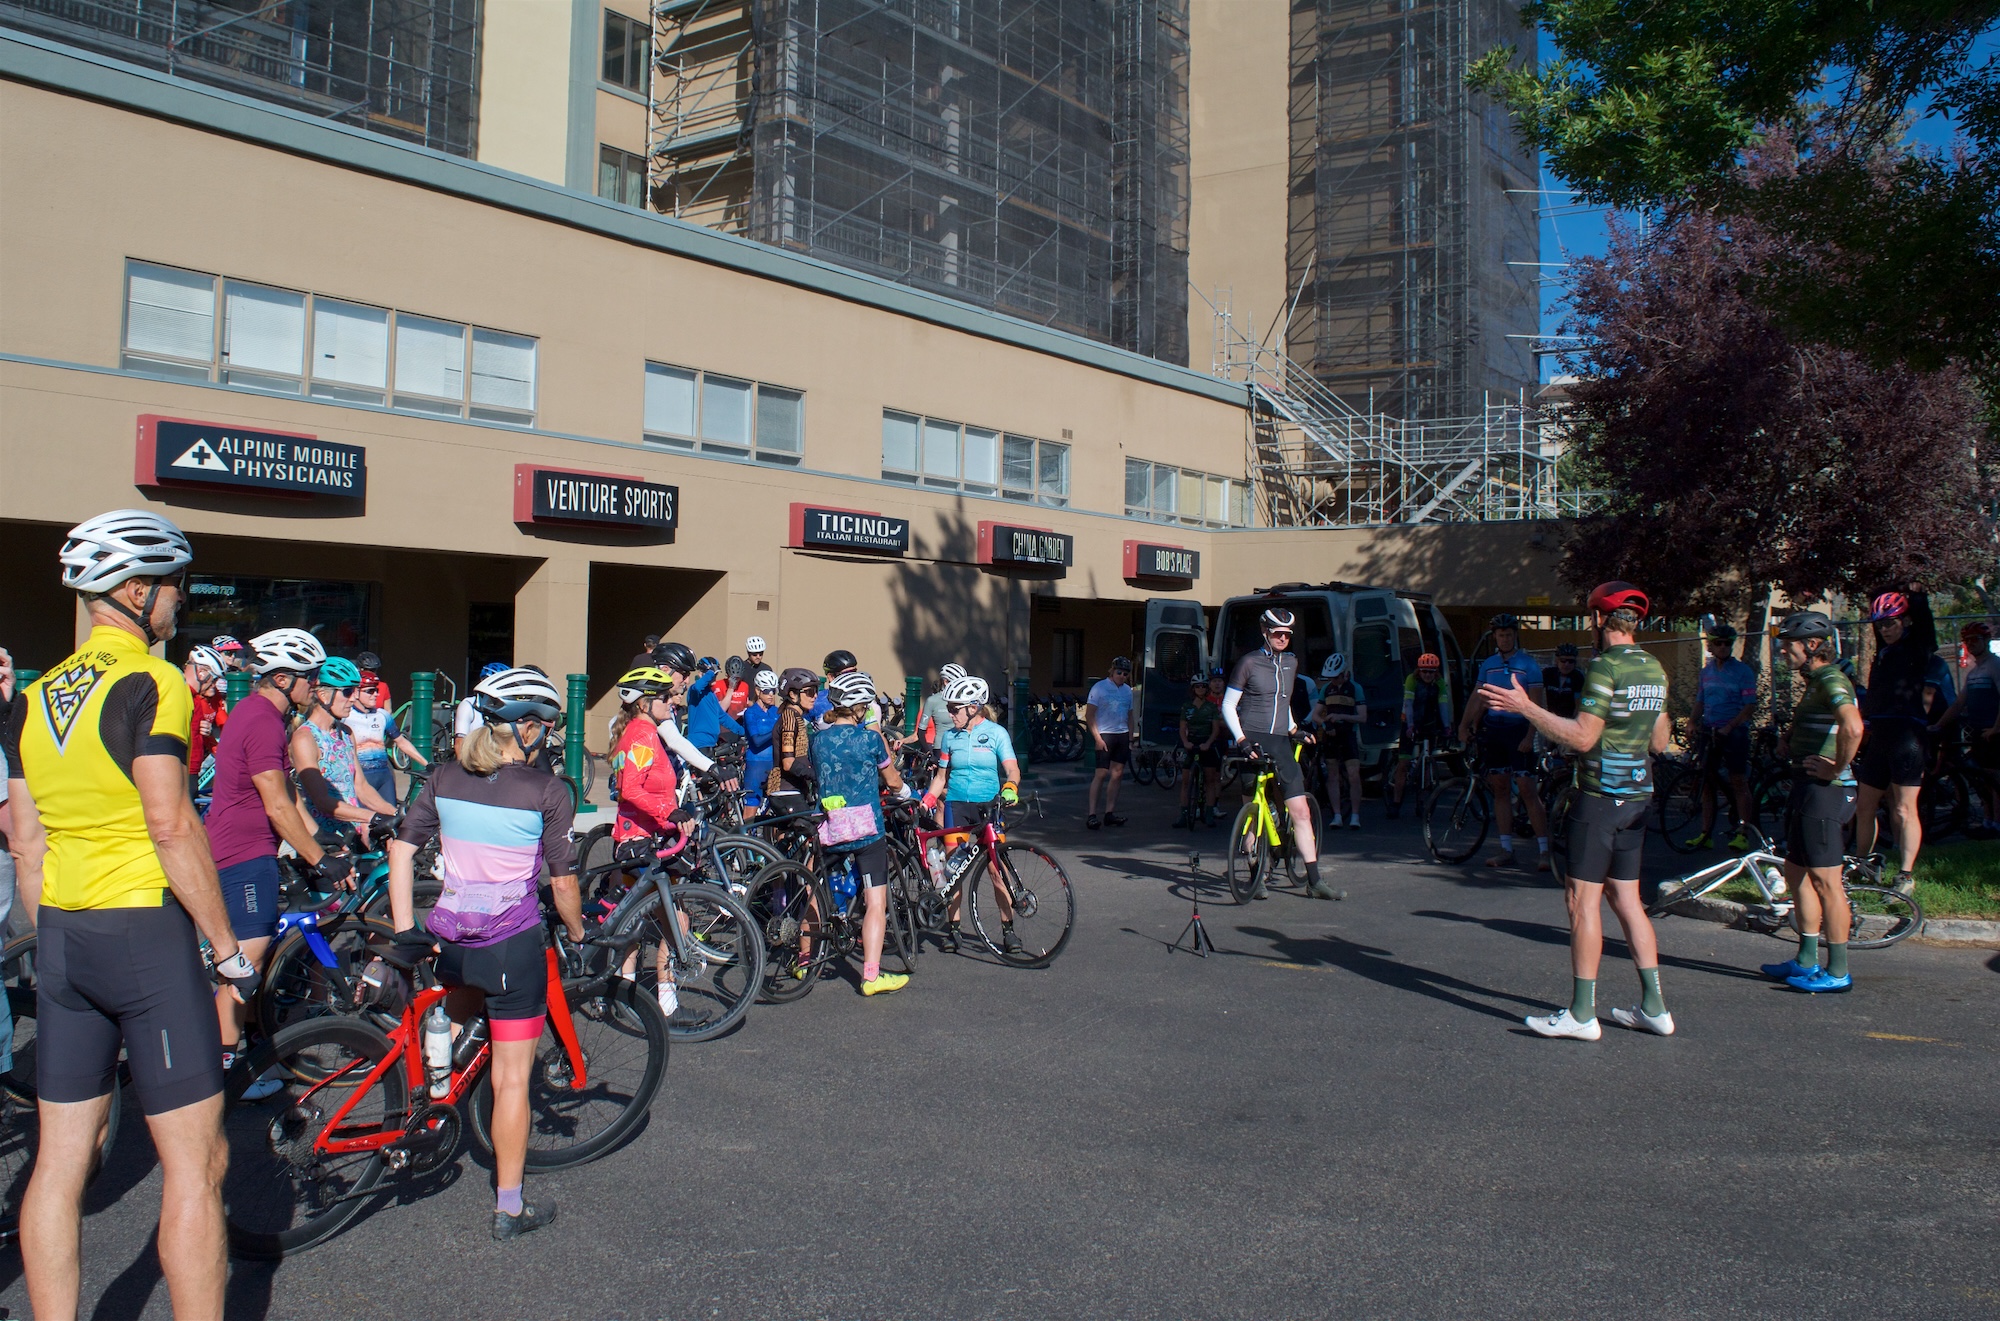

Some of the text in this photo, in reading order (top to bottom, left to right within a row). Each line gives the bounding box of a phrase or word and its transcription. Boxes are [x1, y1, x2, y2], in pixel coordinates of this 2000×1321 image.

[218, 437, 358, 470] ALPINE MOBILE
[233, 459, 353, 489] PHYSICIANS
[547, 479, 673, 521] VENTURE SPORTS
[817, 531, 901, 547] ITALIAN RESTAURANT
[818, 513, 889, 538] TICINO
[1012, 532, 1065, 561] CHINA GARDEN
[1155, 550, 1192, 574] BOB'S PLACE
[44, 651, 118, 678] VALLEY VELO
[1628, 699, 1664, 712] GRAVE
[940, 844, 980, 899] PINARELLO
[244, 883, 259, 914] CYCOLOGY
